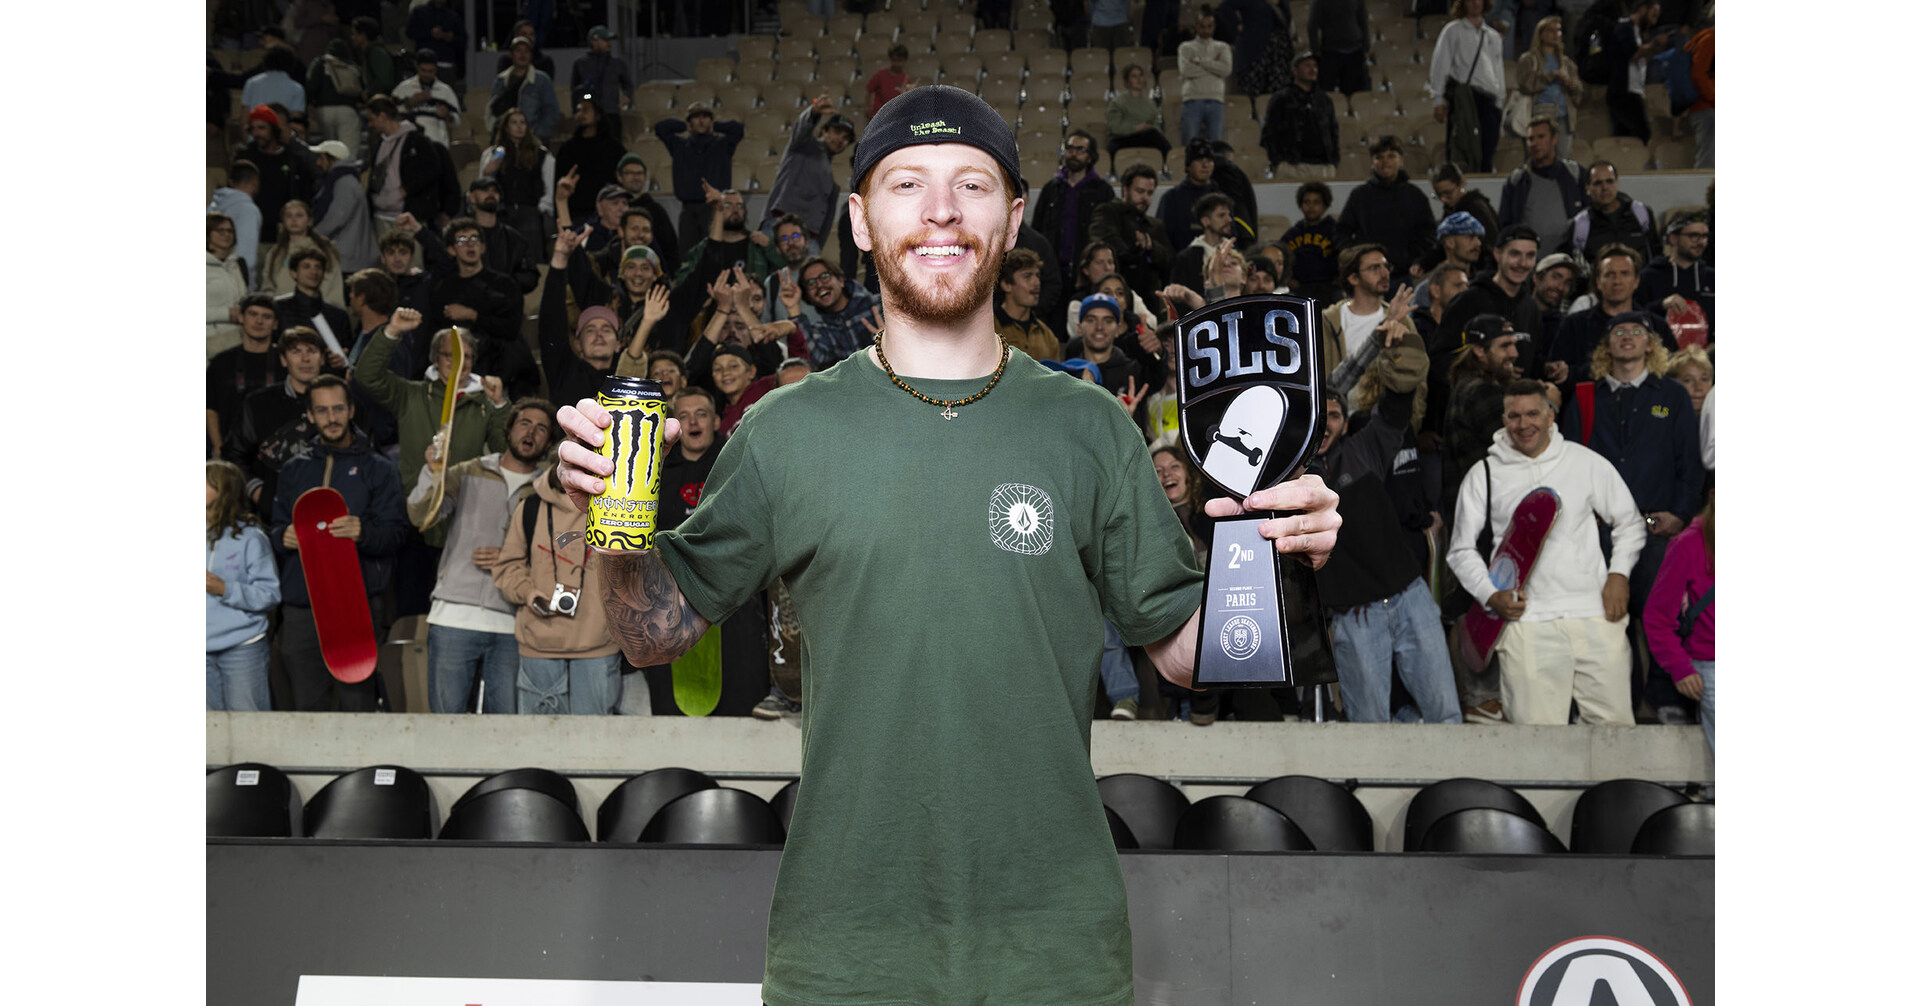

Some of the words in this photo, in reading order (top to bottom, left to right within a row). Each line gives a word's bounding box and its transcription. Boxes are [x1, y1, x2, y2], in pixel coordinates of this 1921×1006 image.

[1187, 309, 1302, 388] SLS
[611, 387, 637, 395] LANDO
[603, 511, 650, 519] ENERGY
[600, 518, 623, 528] ZERO
[623, 520, 650, 528] SUGAR
[1228, 543, 1254, 569] 2ND
[1225, 592, 1257, 607] PARIS
